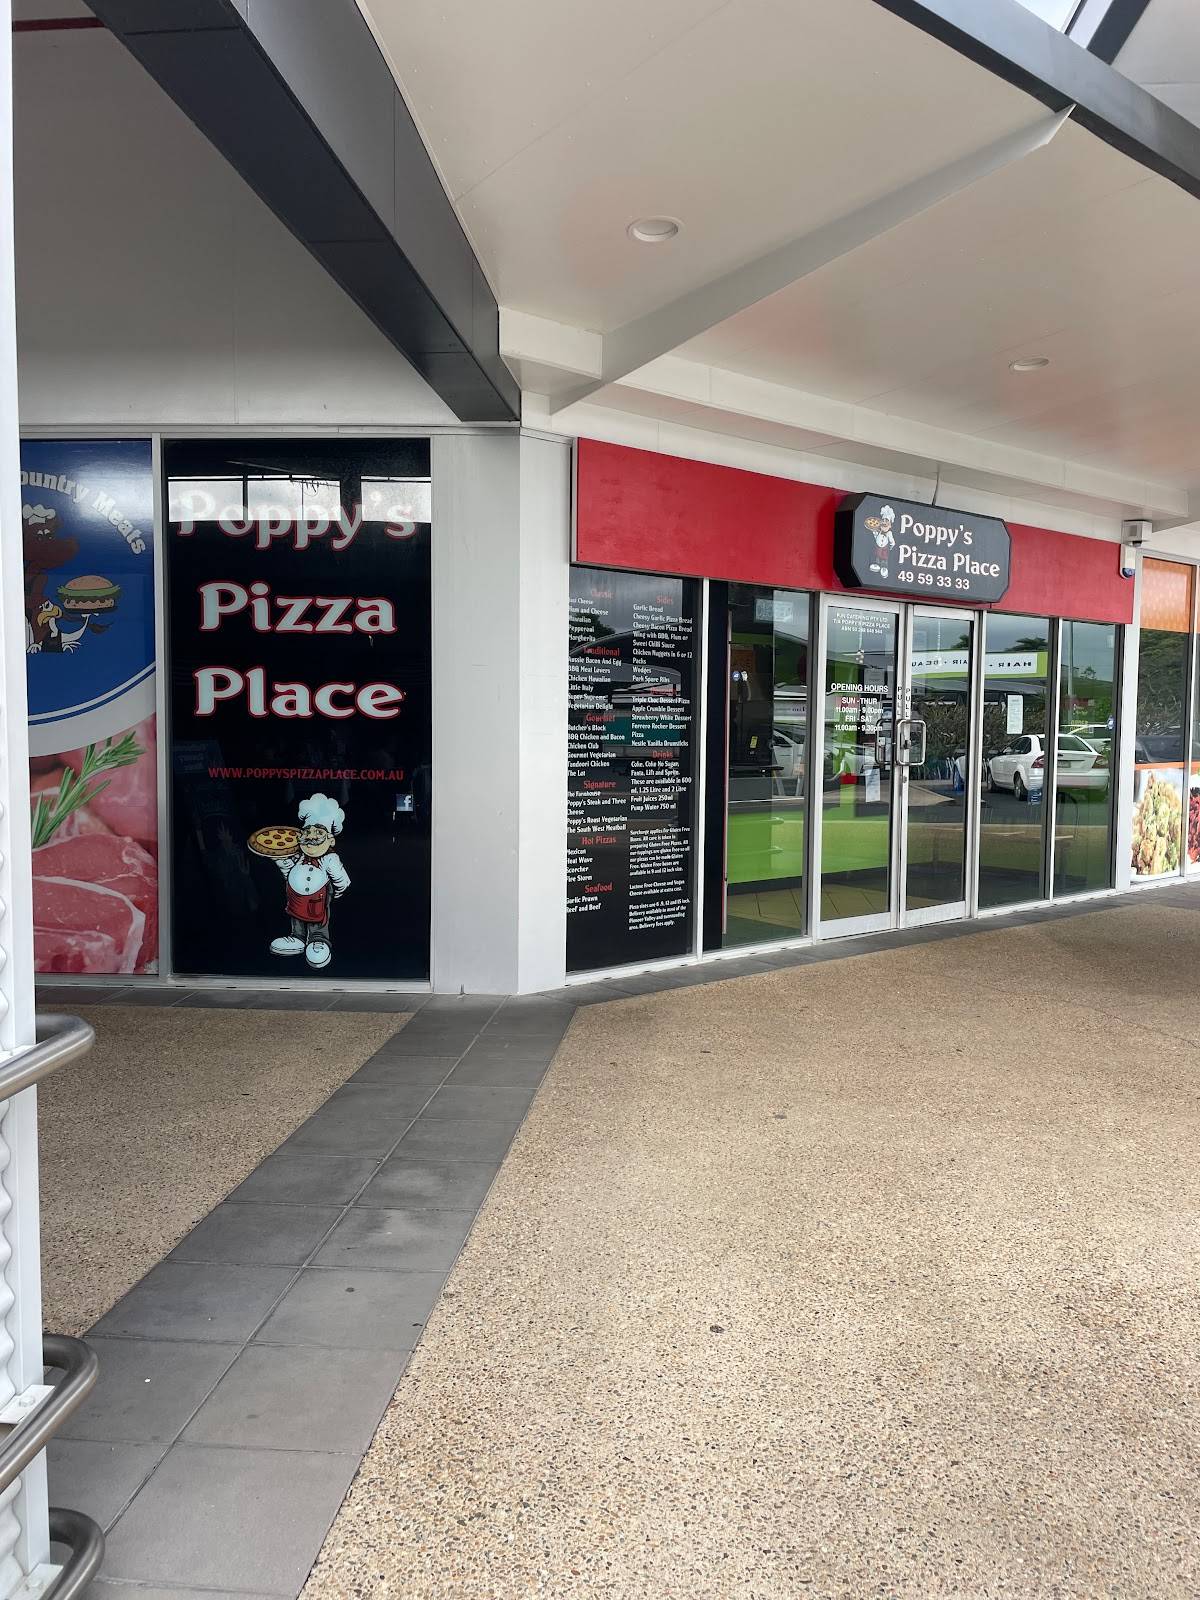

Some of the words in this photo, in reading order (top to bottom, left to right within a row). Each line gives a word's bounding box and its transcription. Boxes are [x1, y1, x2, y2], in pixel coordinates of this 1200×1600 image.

[20, 470, 91, 504] ountry
[92, 490, 146, 555] Meats
[176, 488, 416, 550] Poppy's
[900, 514, 973, 548] Poppy's
[898, 544, 947, 571] Pizza
[952, 552, 1001, 578] Place
[897, 570, 914, 583] 49
[917, 572, 933, 586] 59
[936, 575, 952, 588] 33
[955, 577, 970, 590] 33
[577, 597, 594, 605] Cheese
[198, 580, 399, 635] Pizza
[590, 607, 609, 616] Cheese
[633, 603, 648, 612] Garlic
[648, 605, 664, 613] Bread
[633, 612, 650, 622] Cheesy
[650, 614, 666, 622] Garlic
[666, 615, 678, 623] Pizza
[678, 616, 693, 624] Bread
[569, 624, 595, 634] Pepperoni
[633, 621, 650, 631] Cheesy
[650, 622, 666, 631] Bacon
[665, 624, 678, 632] Pizza
[678, 625, 693, 633] Bread
[569, 633, 596, 642] Margherita
[646, 631, 657, 639] with
[670, 633, 682, 641] Plum
[632, 639, 648, 647] Sweet
[648, 640, 661, 648] Chilli
[661, 641, 676, 649] Sauce
[632, 648, 651, 656] Chicken
[651, 649, 670, 658] Nuggets
[676, 650, 680, 658] 6
[687, 651, 693, 659] 12
[568, 656, 585, 664] Aussie
[585, 656, 600, 664] Bacon
[601, 657, 611, 665] And
[612, 658, 622, 667] Egg
[632, 656, 647, 665] Packs
[568, 665, 579, 673] BBQ
[580, 665, 593, 673] Meat
[593, 666, 610, 674] Lovers
[632, 665, 652, 674] Wedges
[568, 674, 588, 682] Chicken
[588, 675, 611, 683] Hawaiian
[632, 674, 645, 682] Pork
[645, 675, 660, 683] Spare
[193, 665, 405, 719] Place
[582, 683, 594, 693] Italy
[831, 682, 863, 692] OPENING
[864, 684, 889, 693] HOURS
[841, 696, 856, 704] SUN
[859, 697, 878, 705] THUR
[568, 701, 594, 711] Vegetarian
[631, 705, 646, 713] Apple
[586, 712, 616, 723] Gourmet
[631, 713, 660, 722] Strawberry
[845, 715, 856, 723] FRI
[860, 715, 873, 723] SAT
[591, 724, 607, 732] Block
[631, 722, 651, 730] Ferrero
[651, 722, 669, 730] Rocher
[669, 722, 687, 730] Dessert
[567, 732, 579, 740] BBQ
[579, 732, 600, 741] Chicken
[600, 733, 610, 741] and
[610, 733, 625, 741] Bacon
[567, 741, 587, 750] Chicken
[587, 741, 600, 750] Club
[567, 751, 589, 759] Gourmet
[589, 751, 617, 760] Vegetarian
[652, 750, 673, 760] Drinks
[567, 760, 589, 768] Tandoori
[590, 760, 610, 768] Chicken
[645, 760, 657, 768] Coke
[657, 760, 665, 768] No
[208, 767, 404, 781] WWW.POPPYSPIZZAPLACE.COM.AU
[567, 769, 577, 777] The
[577, 769, 586, 777] Lot
[645, 769, 655, 777] Lift
[655, 769, 665, 777] and
[583, 779, 617, 790] Signature
[630, 778, 646, 786] These
[654, 777, 676, 785] available
[681, 776, 692, 784] 600
[575, 790, 601, 798] Farmhouse
[639, 786, 650, 794] 1.25
[661, 785, 671, 793] and
[567, 798, 586, 808] Poppy's
[586, 798, 602, 806] Steak
[601, 797, 611, 805] and
[611, 796, 627, 805] Three
[630, 795, 643, 803] Fruit
[642, 794, 658, 804] Juices
[567, 808, 585, 816] Cheese
[630, 803, 645, 812] Pump
[644, 803, 660, 811] Water
[659, 802, 670, 810] 750
[670, 802, 678, 810] ml
[567, 816, 586, 826] Poppy's
[586, 816, 601, 824] Roast
[601, 815, 628, 824] Vegetarian
[567, 826, 576, 834] The
[576, 825, 591, 833] South
[591, 824, 605, 832] West
[605, 823, 627, 832] Meatball
[581, 835, 594, 846] Hot
[595, 834, 617, 845] Pizzas
[578, 856, 593, 864] Wave
[567, 865, 589, 874] Scorcher
[576, 874, 593, 882] Storm
[583, 882, 613, 894] Seafood
[566, 897, 581, 905] Garlic
[581, 895, 598, 903] Prawn
[578, 904, 589, 912] and
[588, 902, 602, 911] Beef
